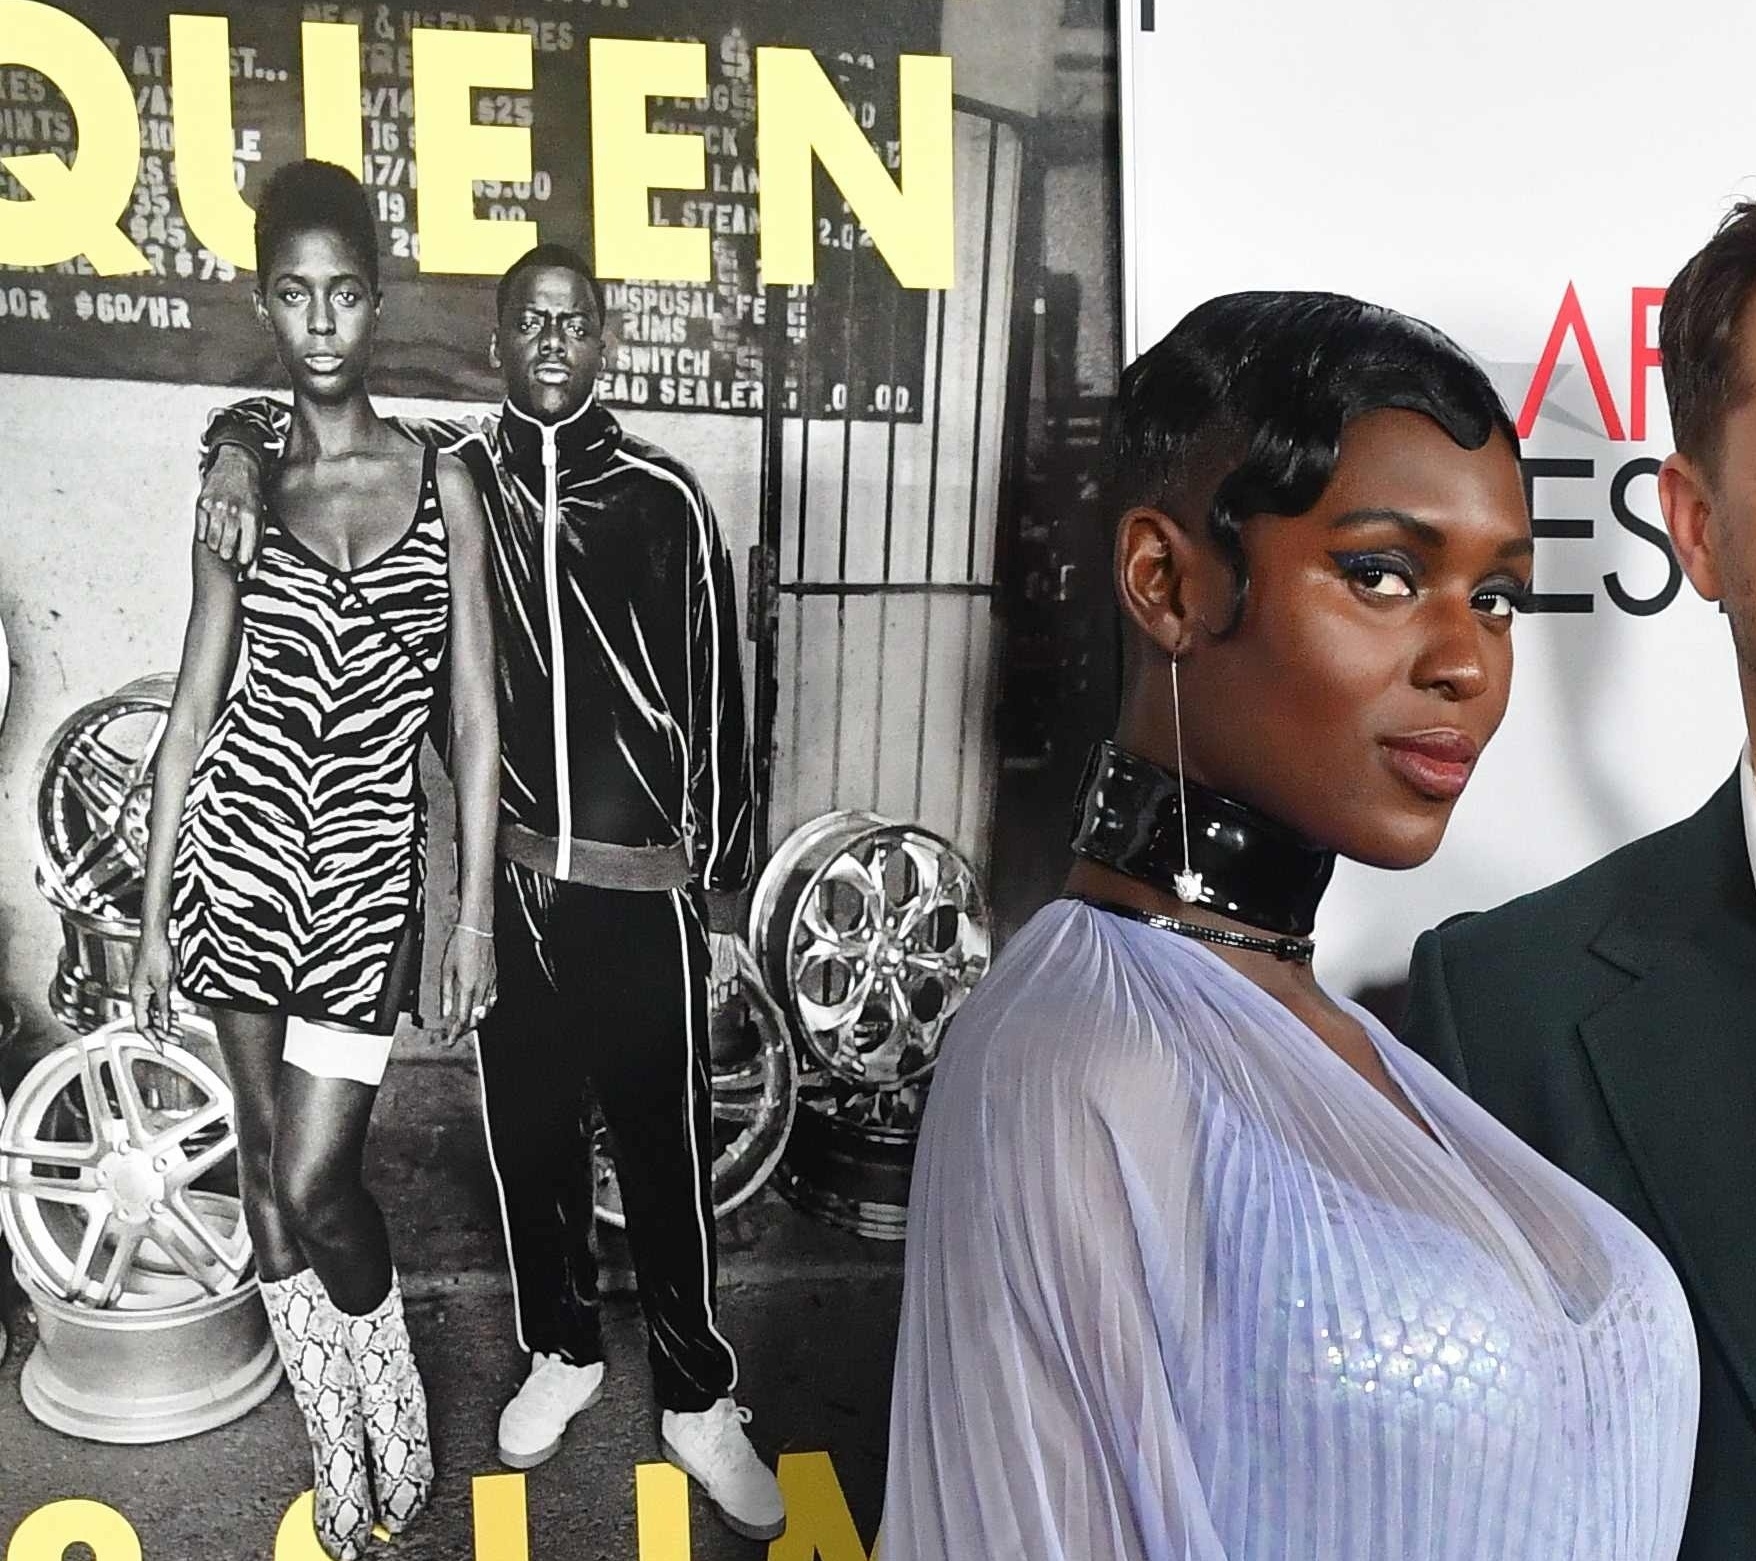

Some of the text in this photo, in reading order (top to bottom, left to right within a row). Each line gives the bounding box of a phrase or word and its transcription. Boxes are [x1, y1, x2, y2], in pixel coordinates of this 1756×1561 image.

[0, 0, 956, 290] QUEEN
[74, 290, 193, 331] $60/HR
[622, 313, 688, 344] RIMS
[616, 346, 711, 378] SWITCH
[1515, 279, 1667, 442] AF
[659, 376, 765, 411] SEALER
[1517, 456, 1684, 617] ES
